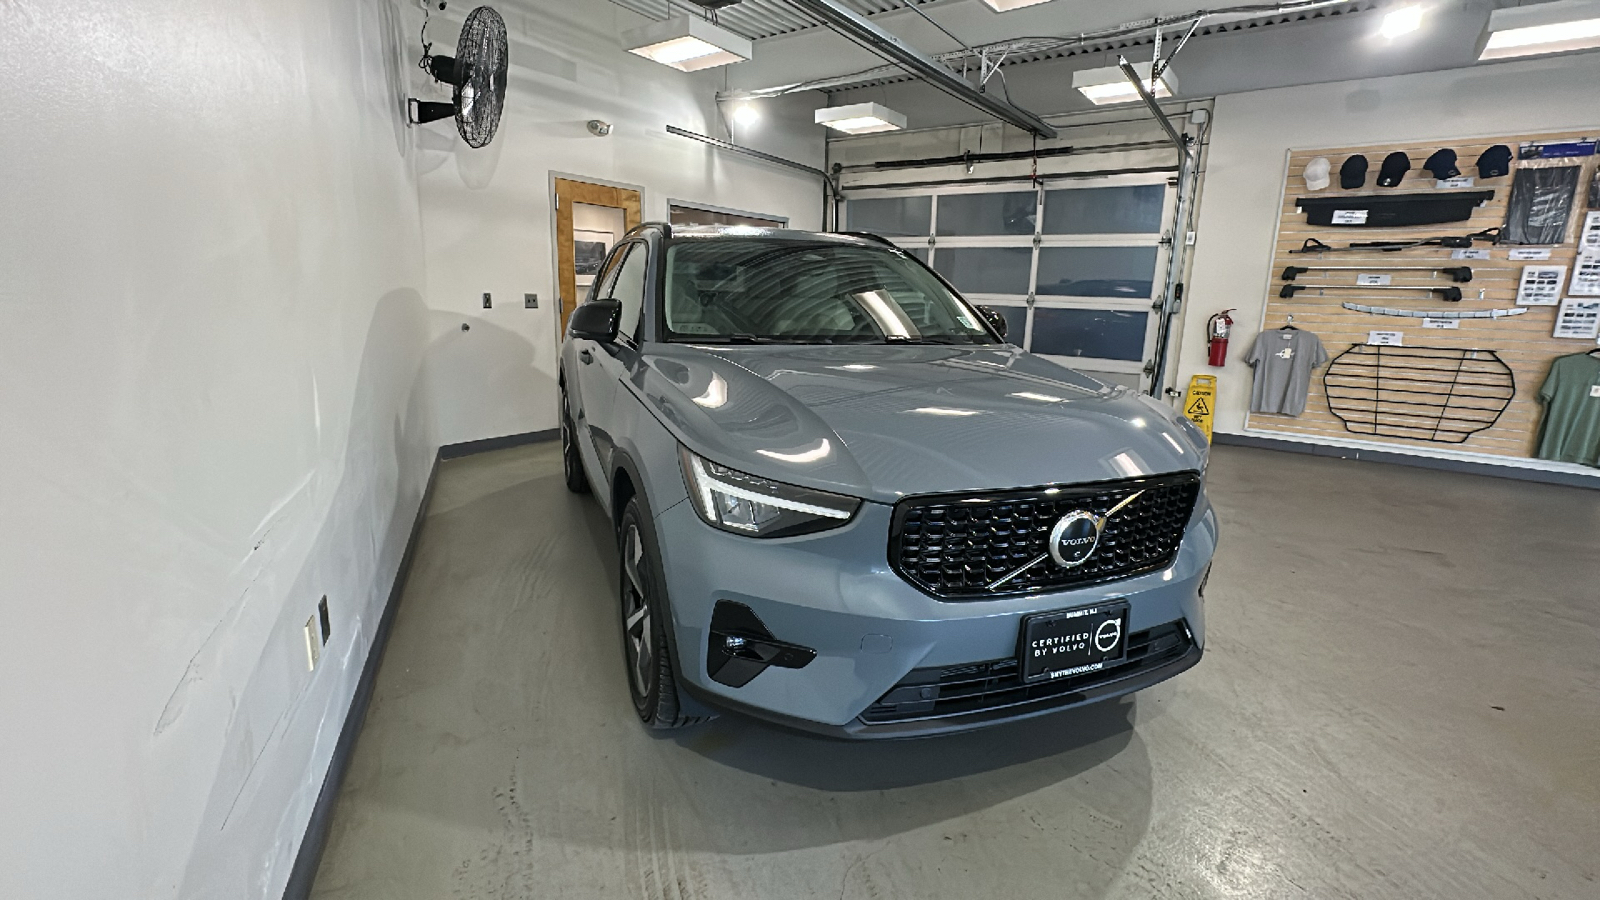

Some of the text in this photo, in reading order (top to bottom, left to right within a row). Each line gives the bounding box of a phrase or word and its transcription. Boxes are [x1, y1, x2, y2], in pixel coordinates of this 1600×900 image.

[1061, 536, 1095, 545] VOLVO
[1032, 632, 1089, 648] CERTIFIED
[1034, 642, 1086, 657] BY VOLVO
